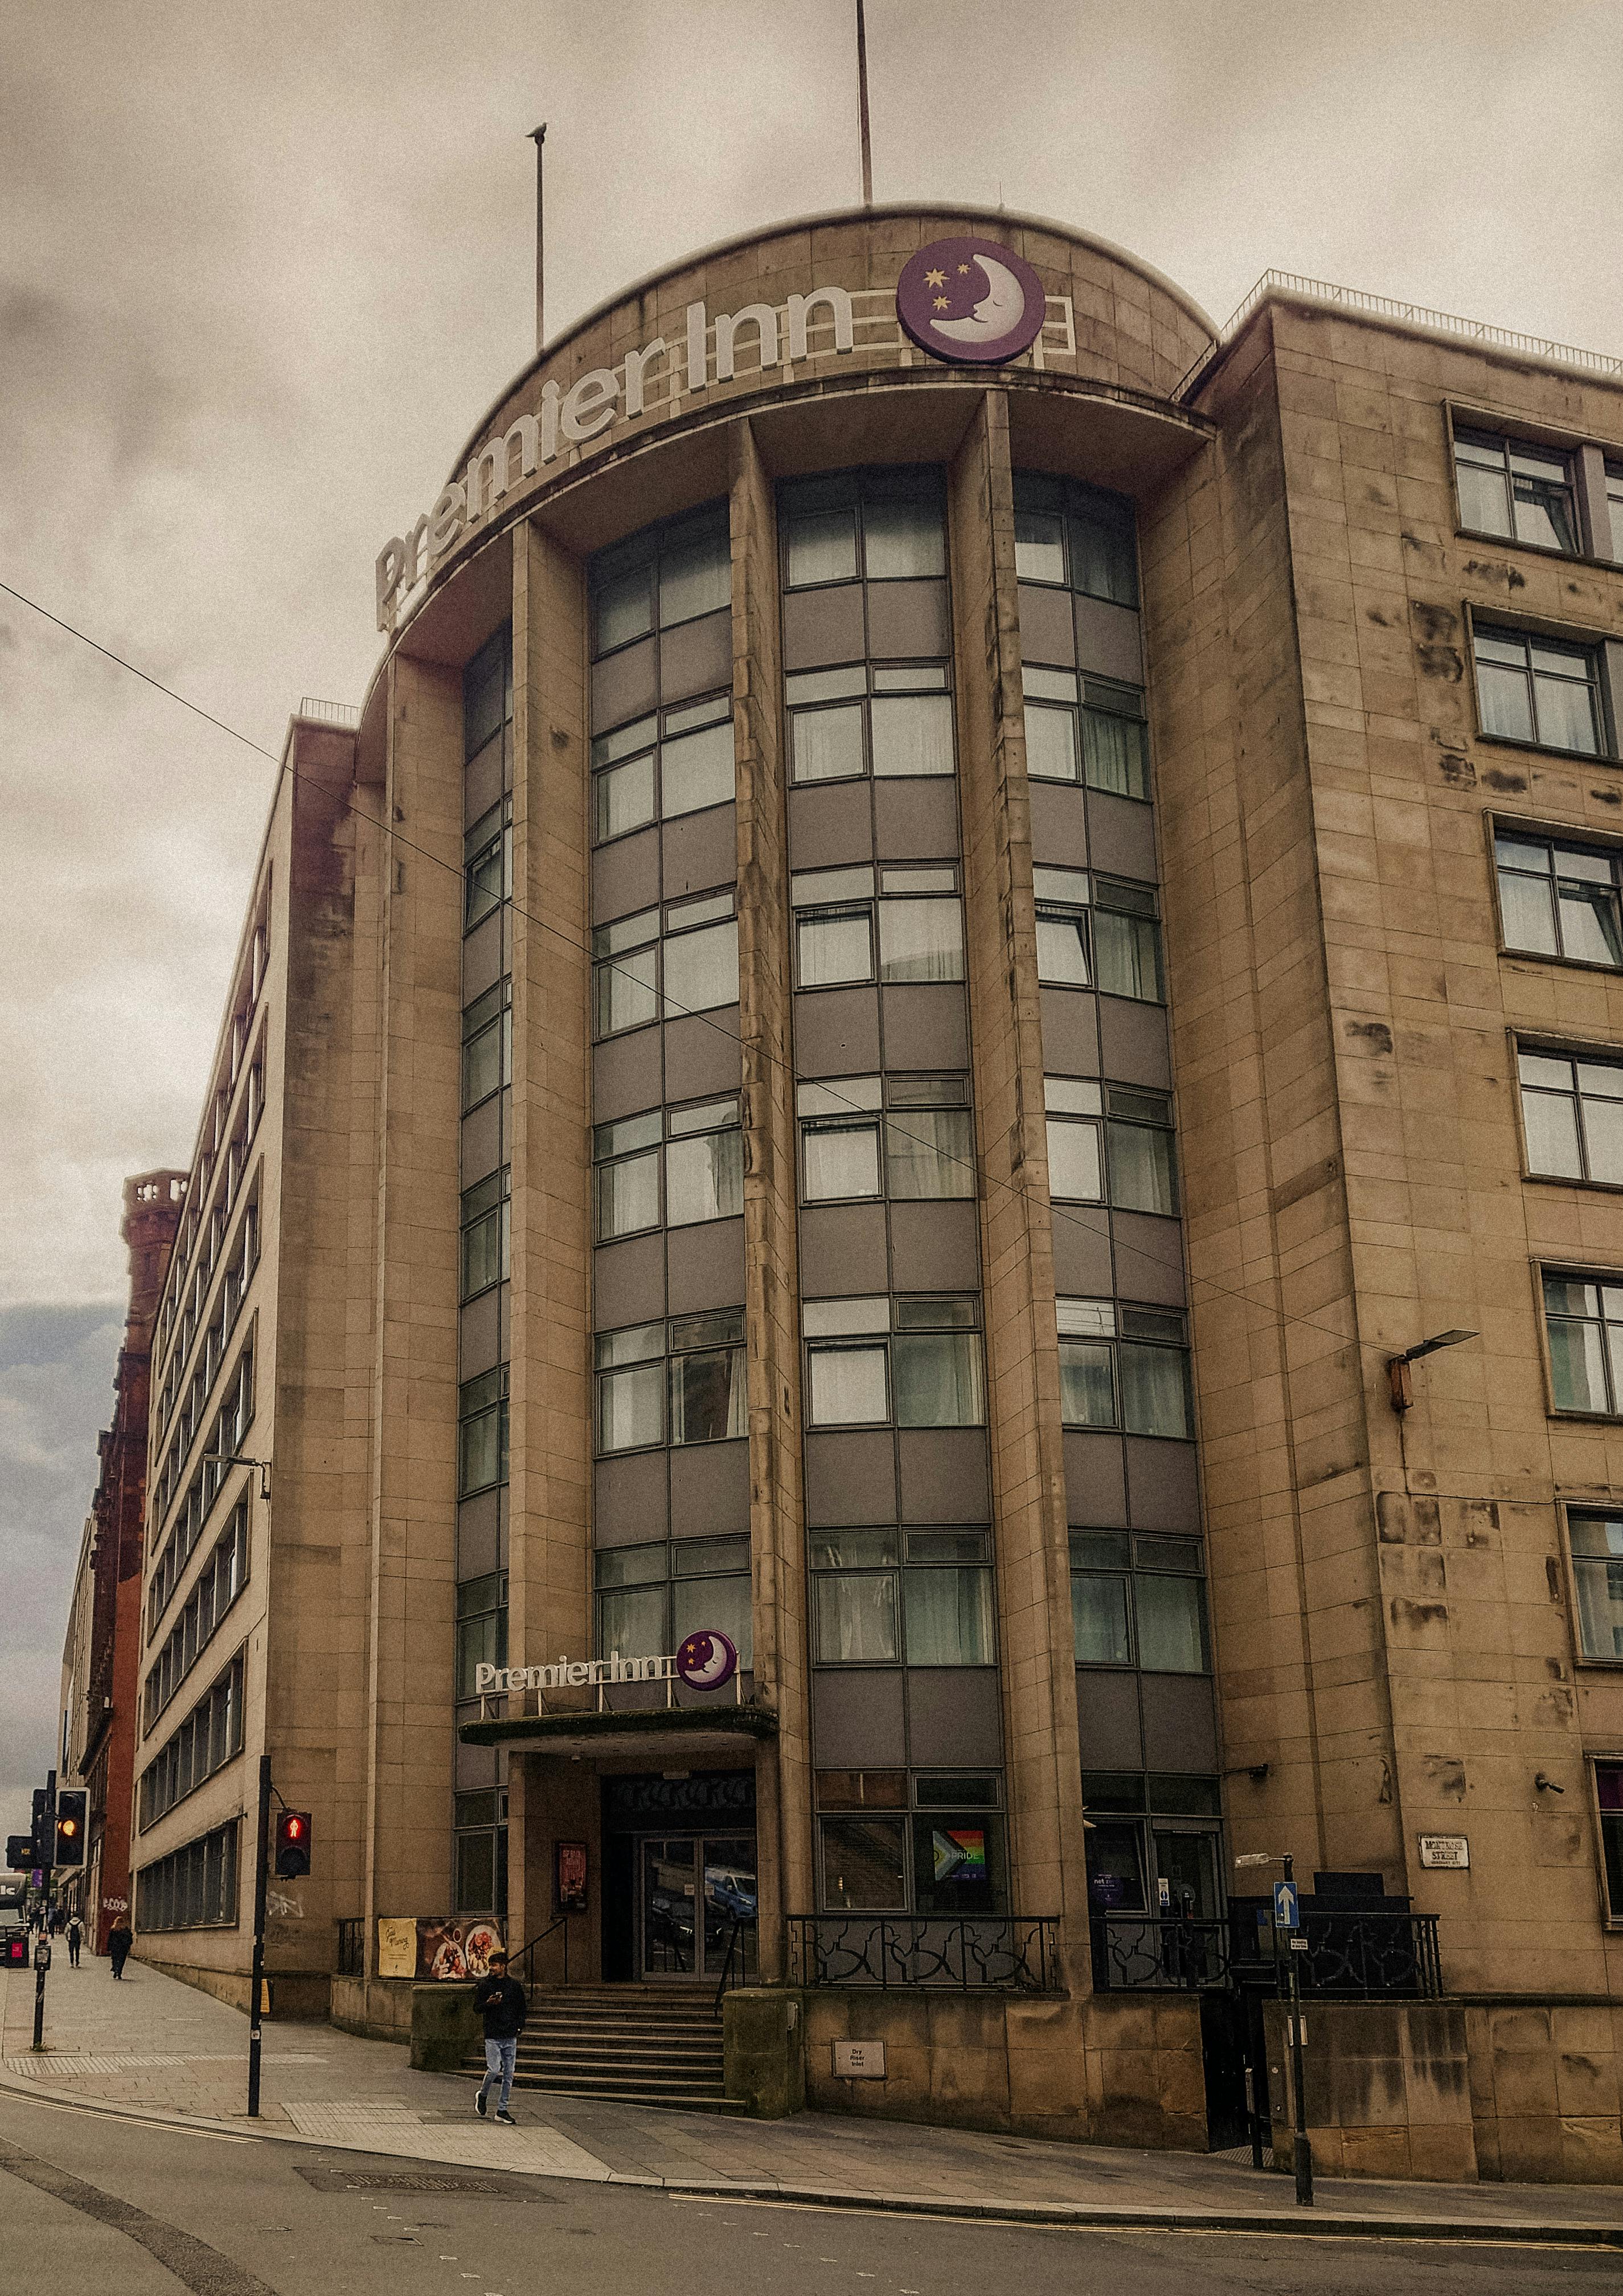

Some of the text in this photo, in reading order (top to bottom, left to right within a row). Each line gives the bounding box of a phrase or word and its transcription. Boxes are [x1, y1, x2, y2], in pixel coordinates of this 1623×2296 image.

[376, 286, 853, 631] Premier Inn
[476, 1651, 662, 1694] Premier Inn
[1425, 1840, 1463, 1850] MONTROSE
[1432, 1851, 1458, 1860] STREET
